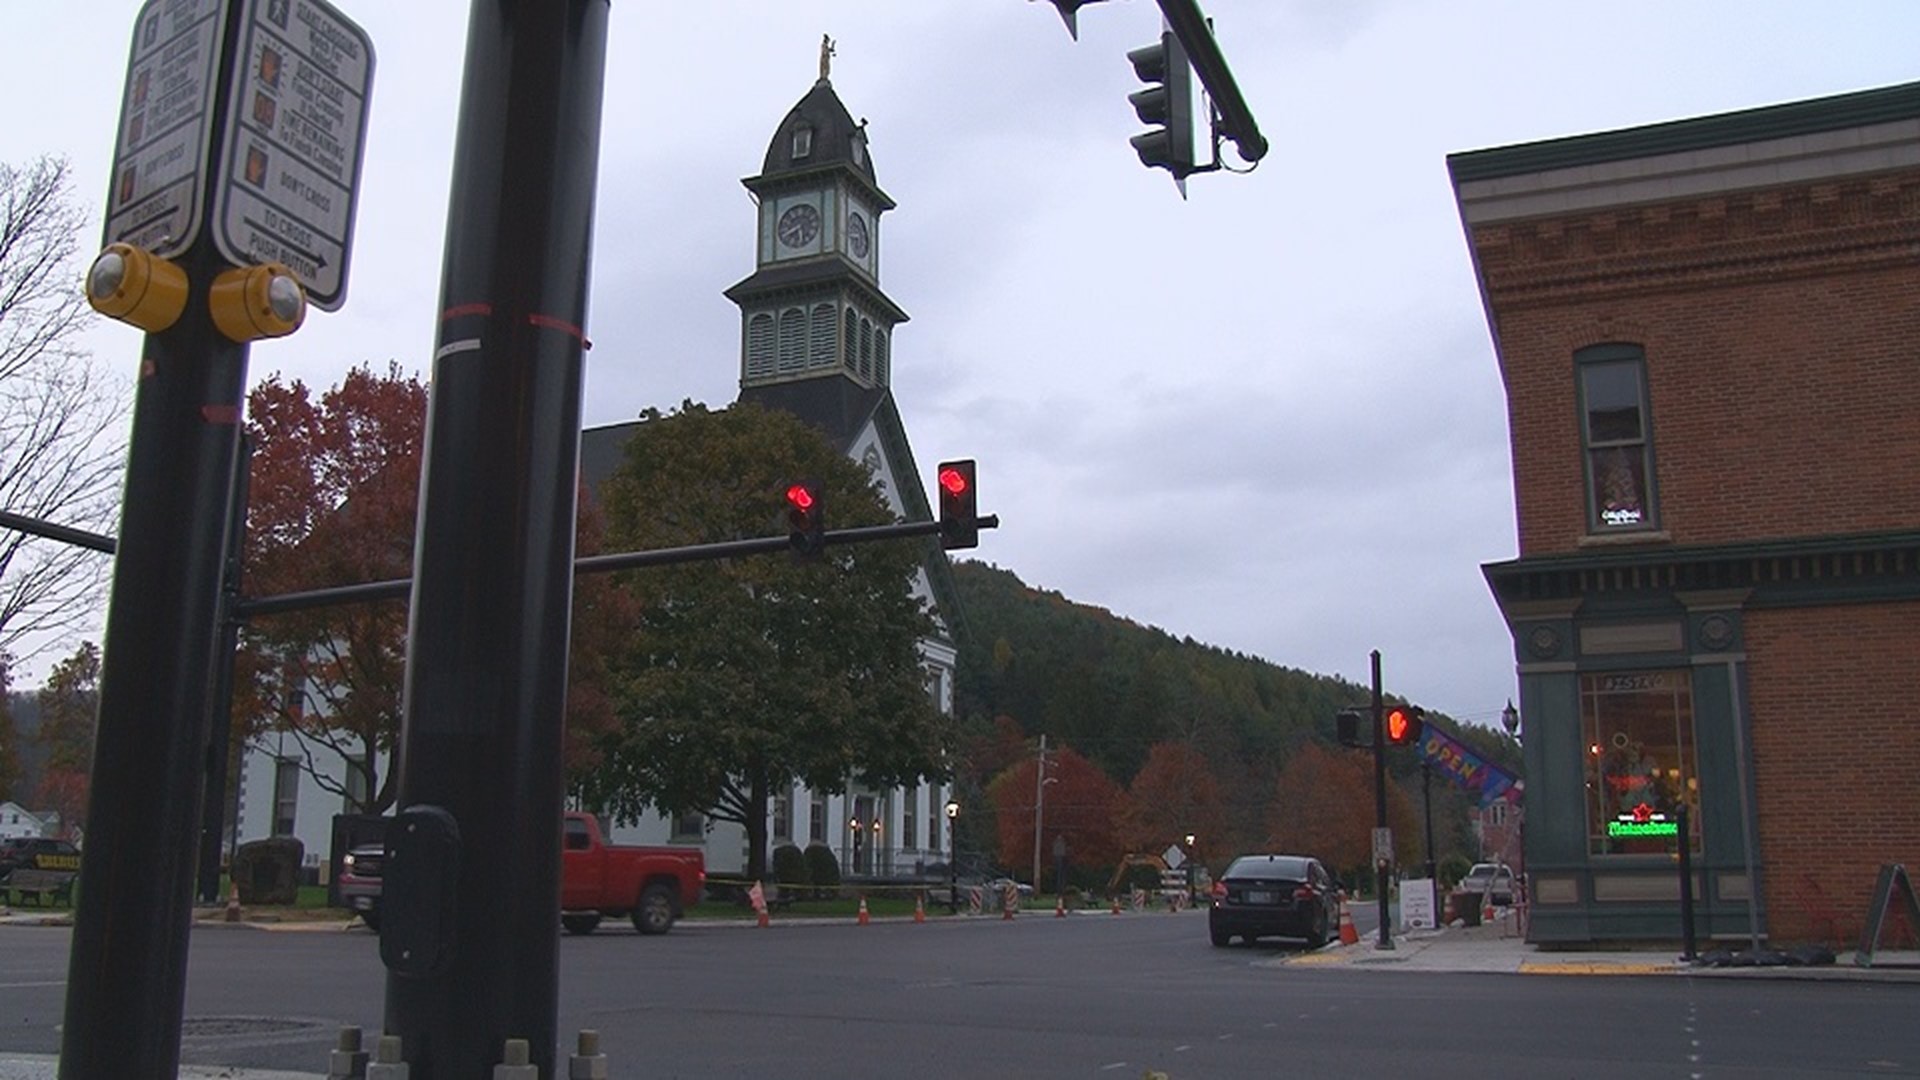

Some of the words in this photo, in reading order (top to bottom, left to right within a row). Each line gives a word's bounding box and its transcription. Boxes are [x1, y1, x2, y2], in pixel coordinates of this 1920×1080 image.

[296, 1, 321, 29] START
[321, 76, 344, 104] START
[282, 108, 301, 133] TIME
[301, 122, 345, 162] REMAINING
[279, 170, 305, 197] DON'T
[304, 185, 331, 214] CROSS
[263, 208, 277, 229] TO
[279, 217, 312, 249] CROSS
[249, 230, 278, 260] PUSH
[279, 247, 317, 282] BUTTON
[1425, 739, 1476, 779] OPEN
